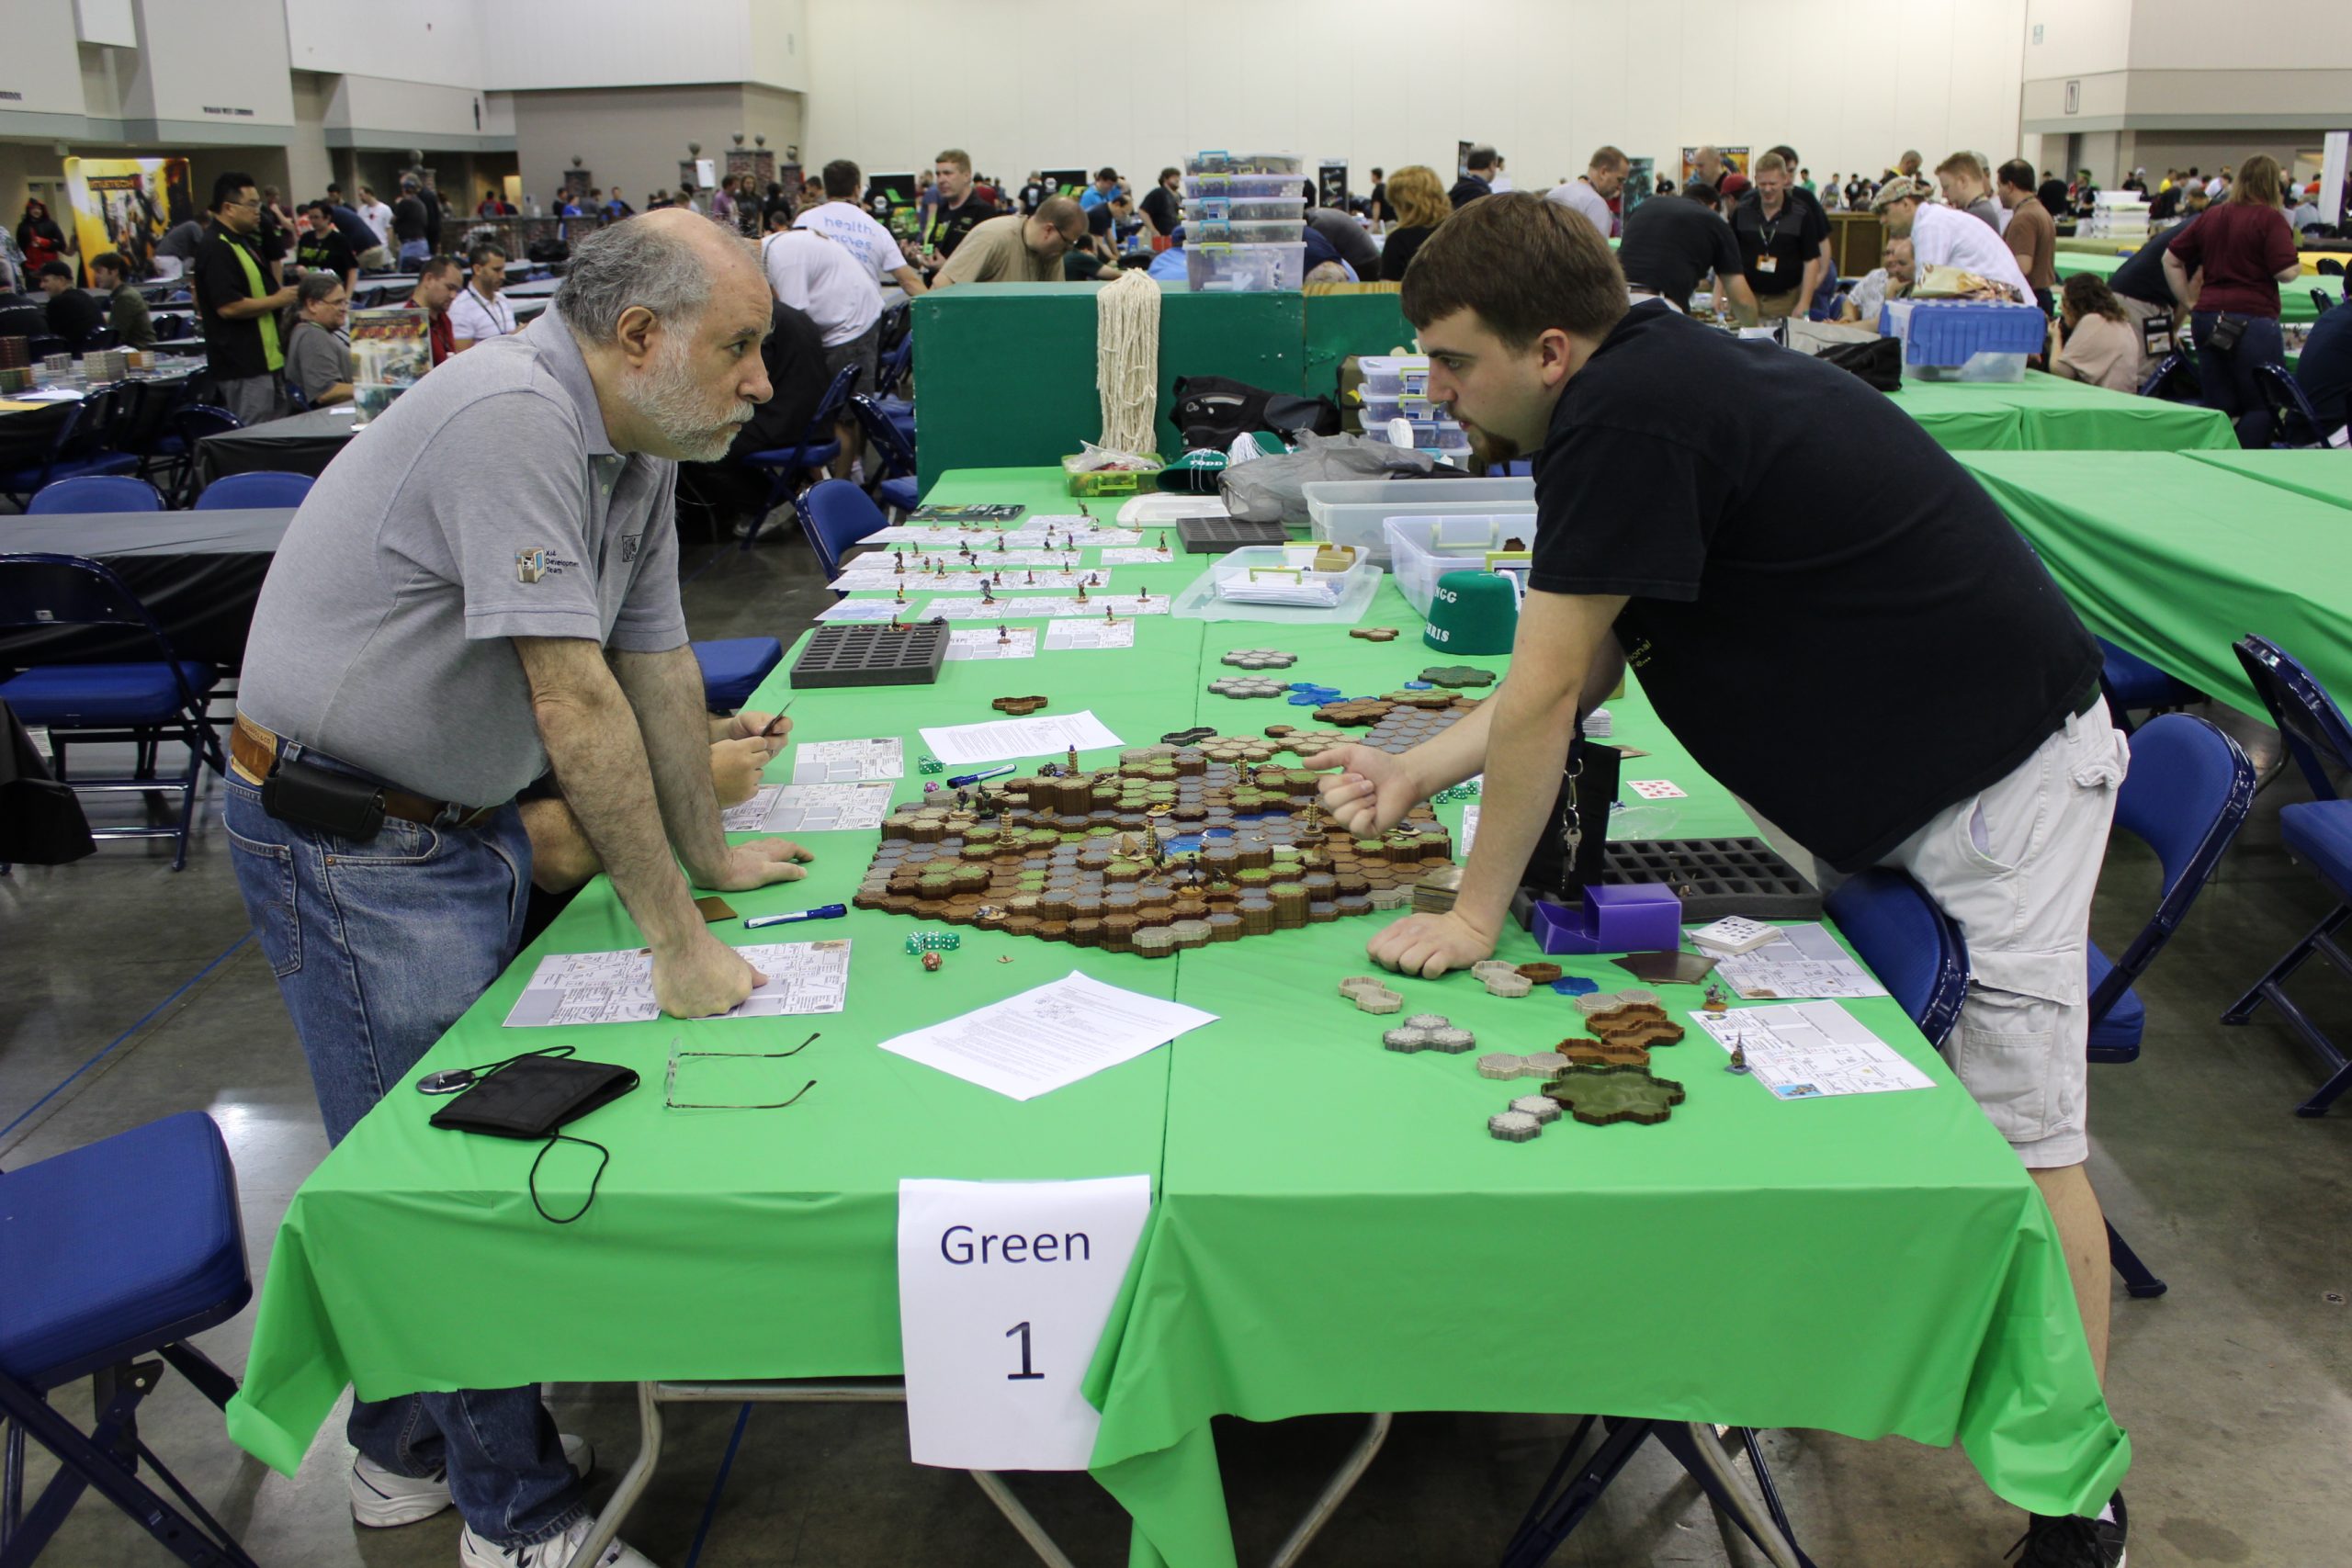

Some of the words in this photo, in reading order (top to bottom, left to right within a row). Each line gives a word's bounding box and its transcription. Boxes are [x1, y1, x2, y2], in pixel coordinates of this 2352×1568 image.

[1425, 622, 1450, 642] HRIS
[941, 1224, 1091, 1266] Green
[1005, 1321, 1046, 1382] 1
